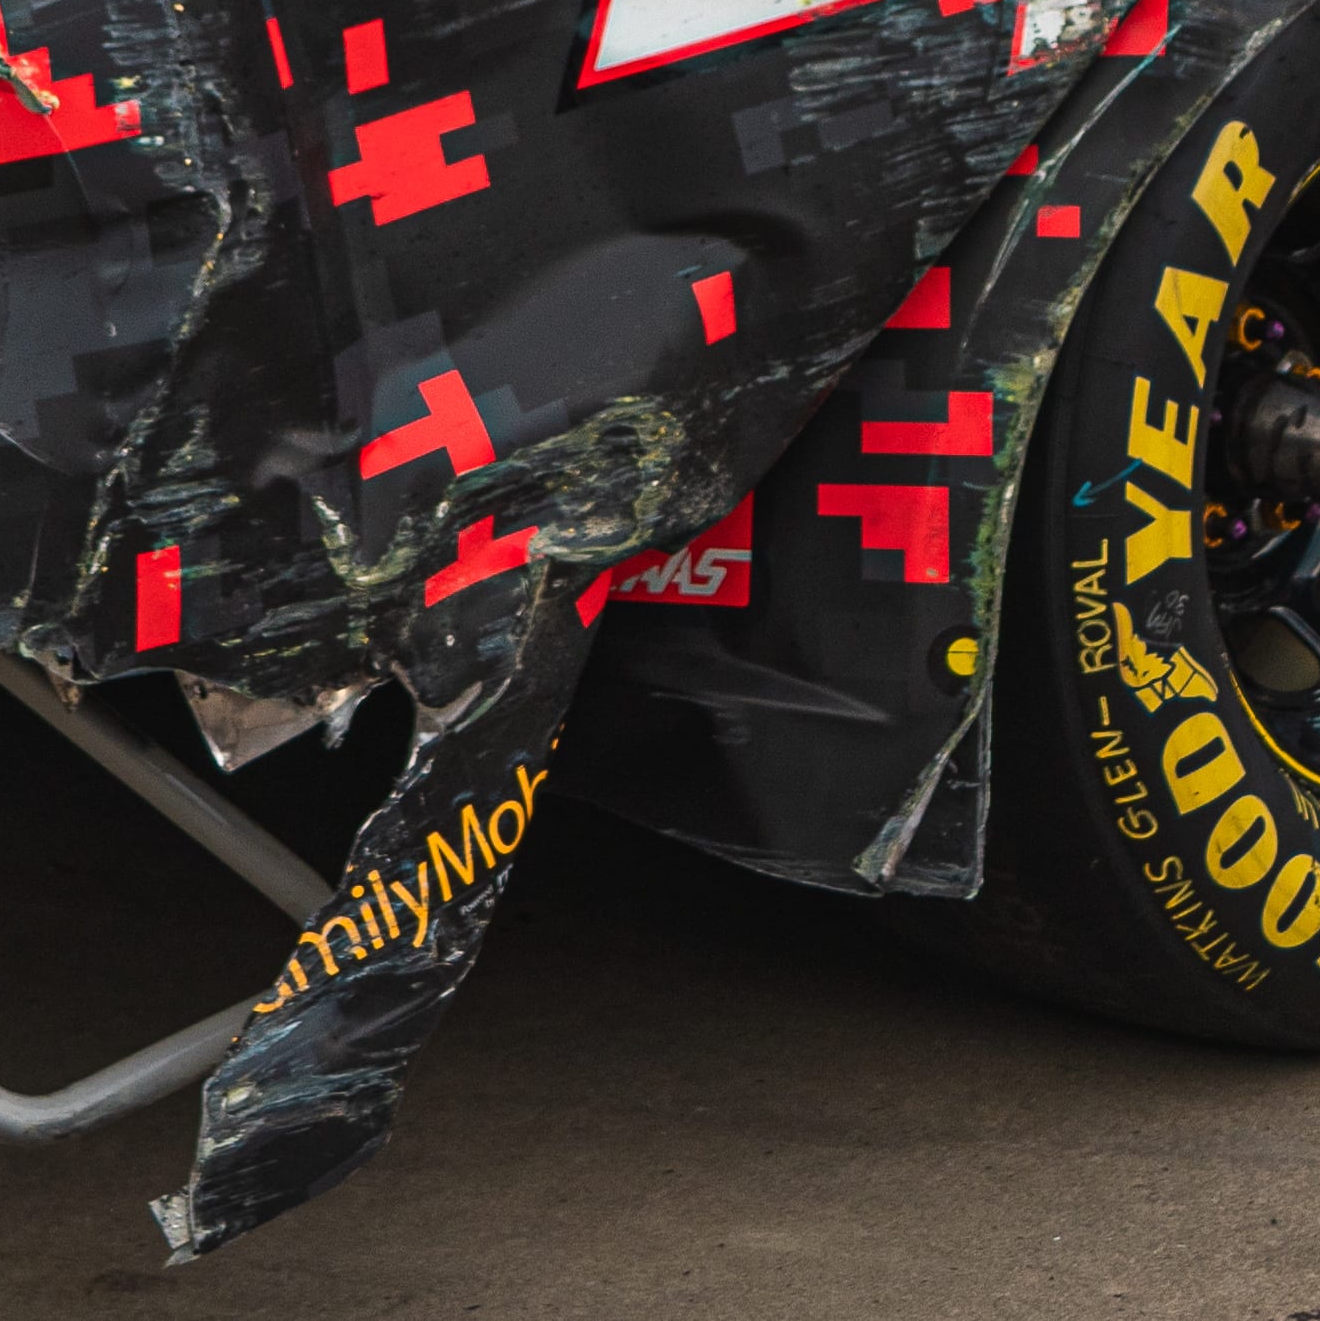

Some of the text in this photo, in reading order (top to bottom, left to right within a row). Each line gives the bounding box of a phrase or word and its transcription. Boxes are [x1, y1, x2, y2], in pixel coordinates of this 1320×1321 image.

[608, 547, 752, 597] AAS
[1071, 538, 1114, 674] ROVAL
[1142, 856, 1272, 992] WATKINS
